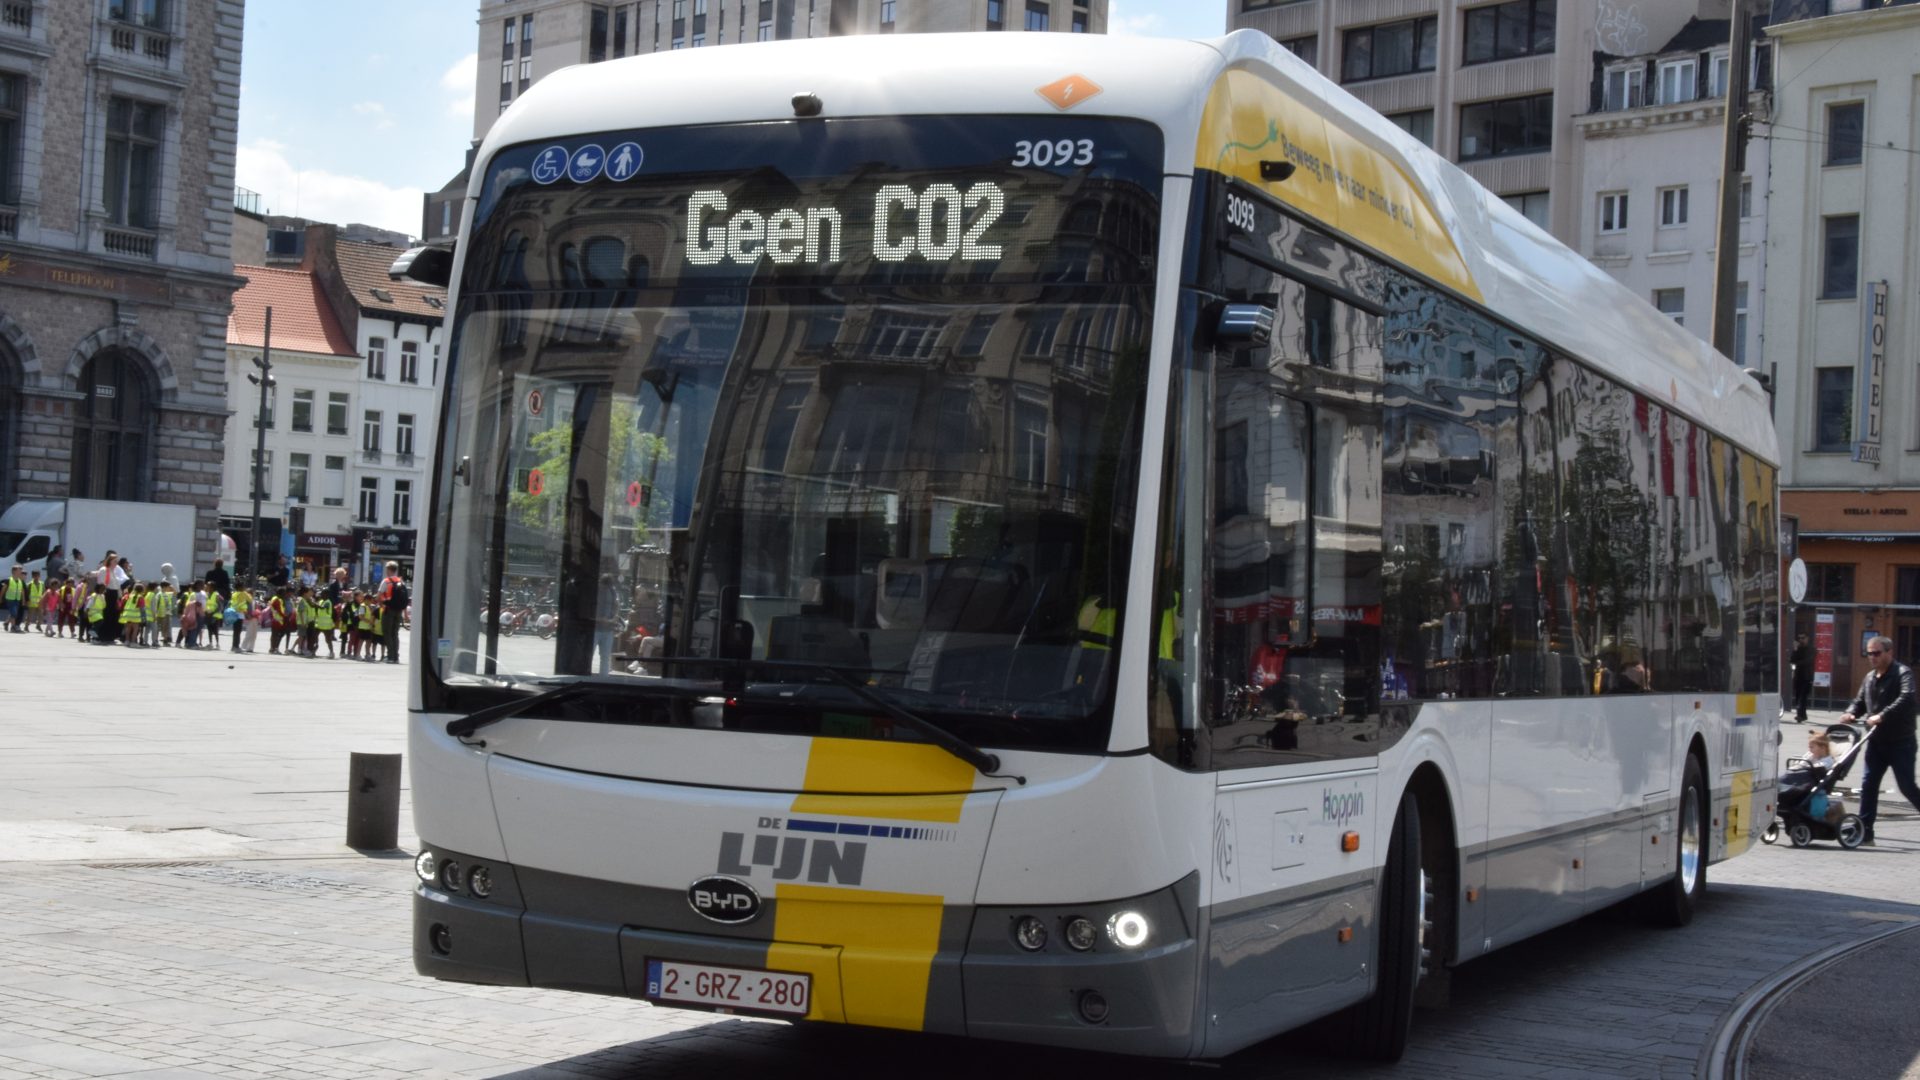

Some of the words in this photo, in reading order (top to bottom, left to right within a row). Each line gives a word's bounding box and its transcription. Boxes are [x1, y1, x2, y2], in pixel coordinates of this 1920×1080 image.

[1012, 138, 1094, 167] 3093
[1281, 134, 1322, 184] Beweeg
[686, 190, 842, 265] Geen
[872, 182, 1004, 261] CO2
[1227, 194, 1255, 232] 3093
[1869, 293, 1885, 438] HOTEL
[1859, 445, 1881, 461] FLOX
[307, 535, 337, 545] ADIOR
[1322, 781, 1364, 829] Hoppin
[758, 816, 782, 830] DE
[717, 831, 867, 886] LIJN
[694, 889, 752, 911] BYD
[649, 982, 659, 994] B
